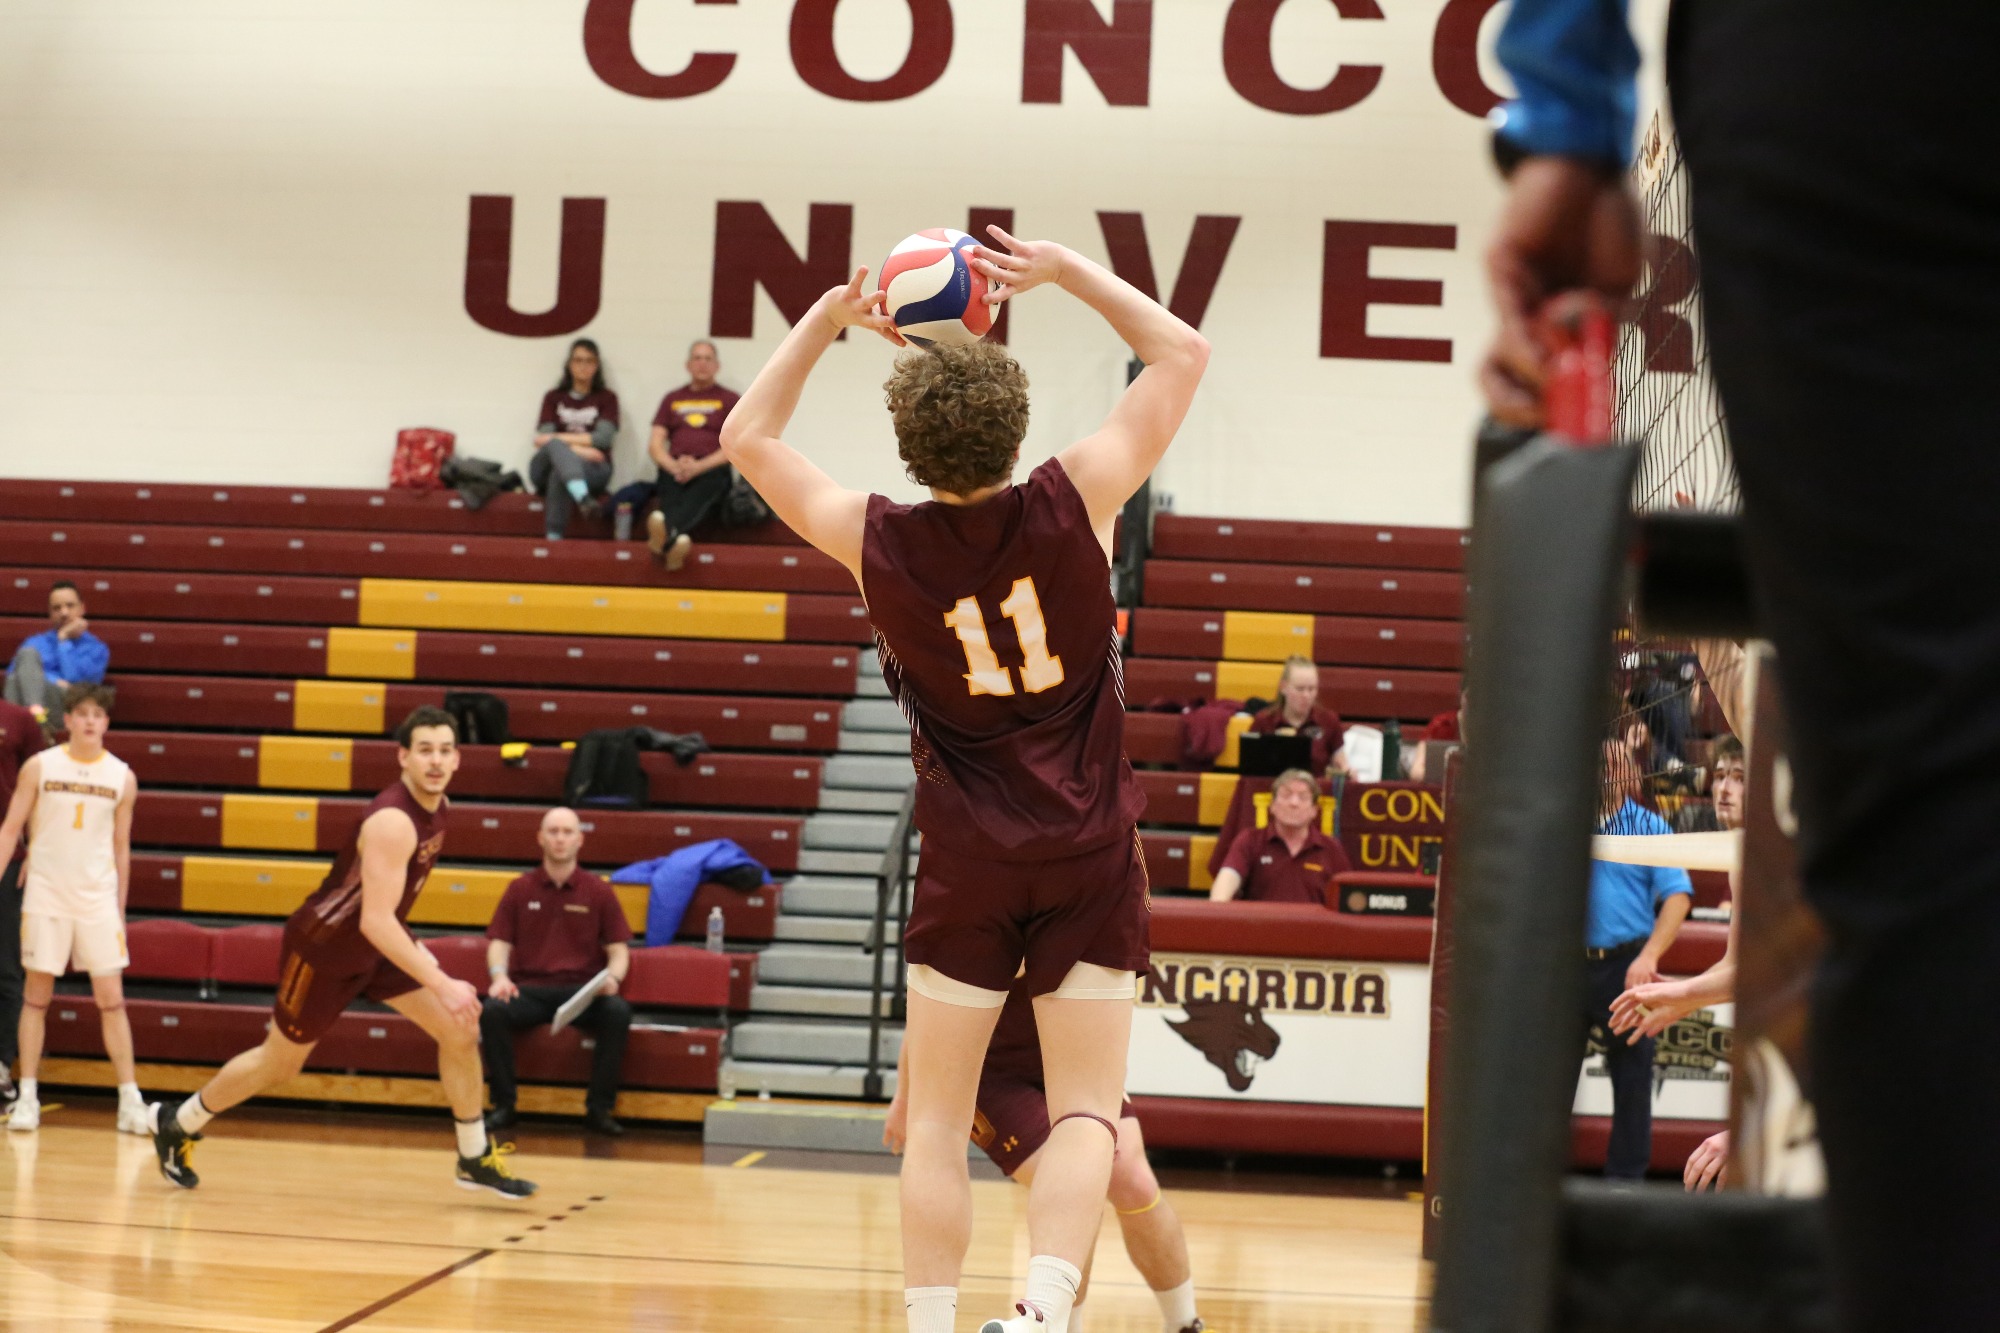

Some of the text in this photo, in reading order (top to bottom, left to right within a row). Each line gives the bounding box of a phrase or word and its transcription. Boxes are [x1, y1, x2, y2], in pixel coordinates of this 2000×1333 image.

[943, 575, 1065, 697] 11
[73, 802, 85, 830] 1
[1360, 834, 1442, 868] UN
[1368, 893, 1408, 911] BONUS
